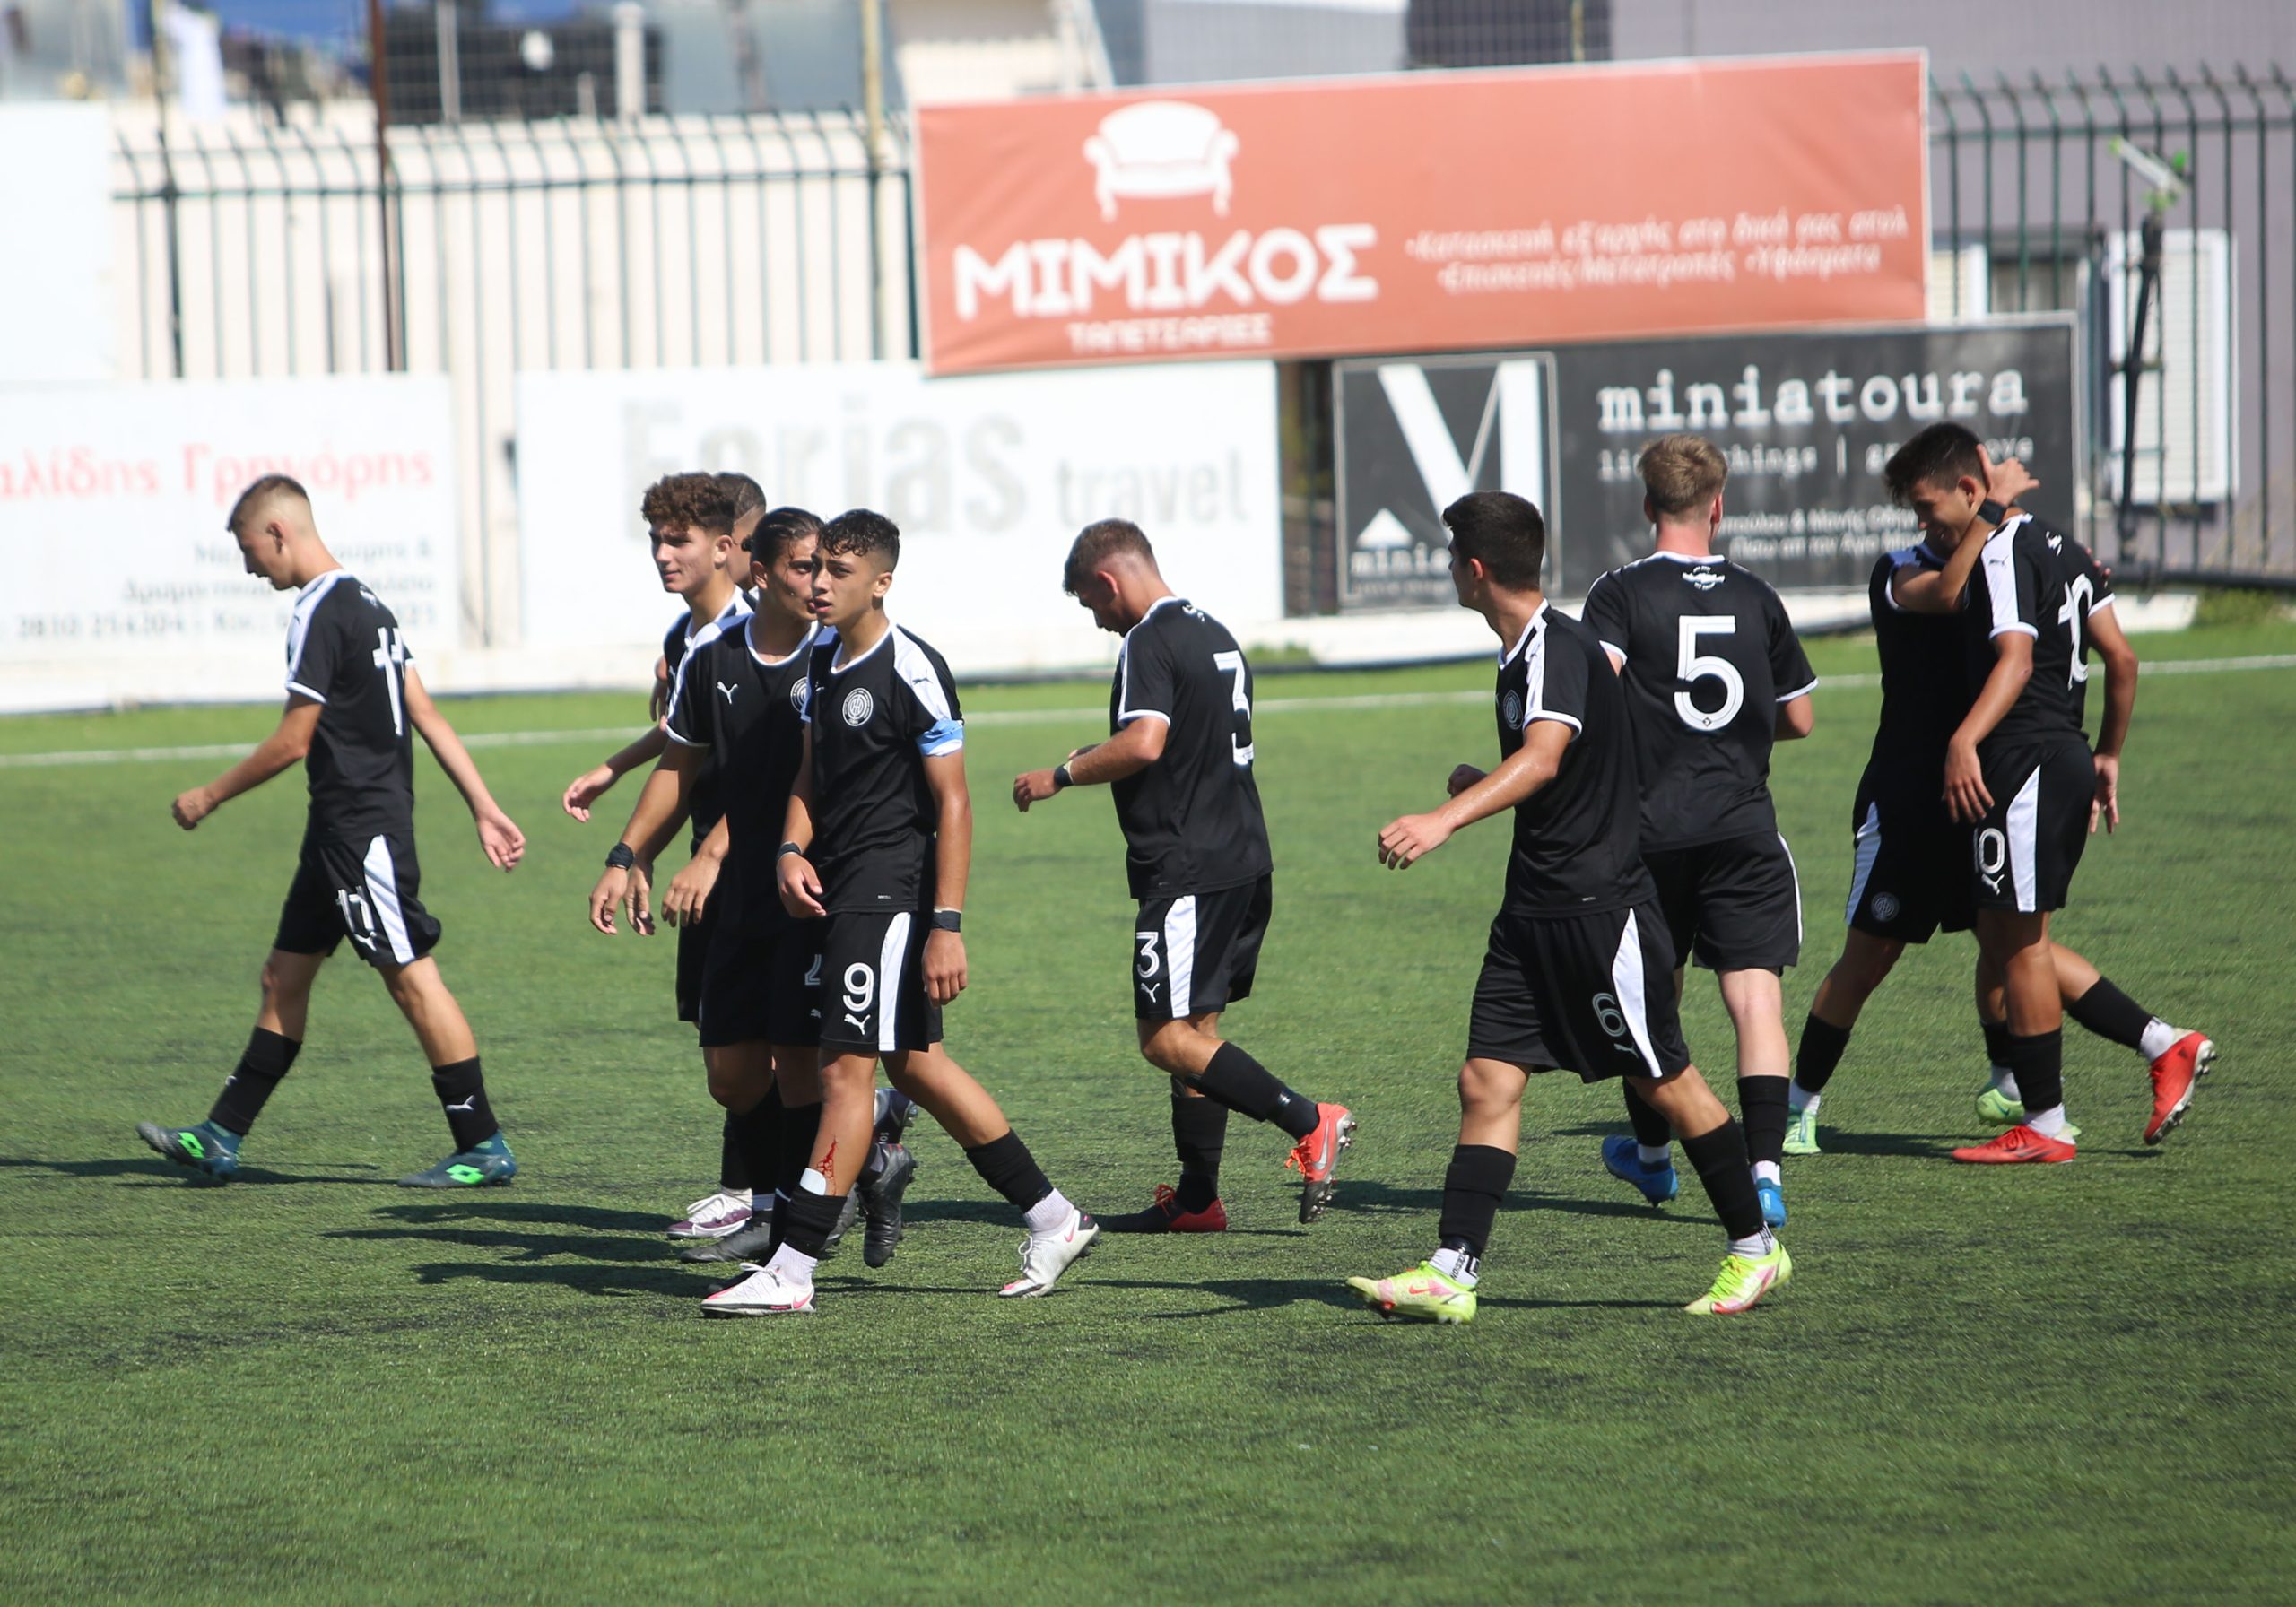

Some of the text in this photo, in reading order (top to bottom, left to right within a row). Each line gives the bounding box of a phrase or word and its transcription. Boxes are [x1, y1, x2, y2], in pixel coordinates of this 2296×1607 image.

[952, 223, 1379, 319] ΜΙΜΙΚΟΣ
[1596, 363, 2030, 433] miniatoura
[1054, 445, 1248, 529] travel
[1213, 649, 1254, 766] 3
[1674, 615, 1744, 731] 5
[843, 962, 874, 1012] 9
[1136, 931, 1161, 979] 3
[1592, 992, 1626, 1038] 6
